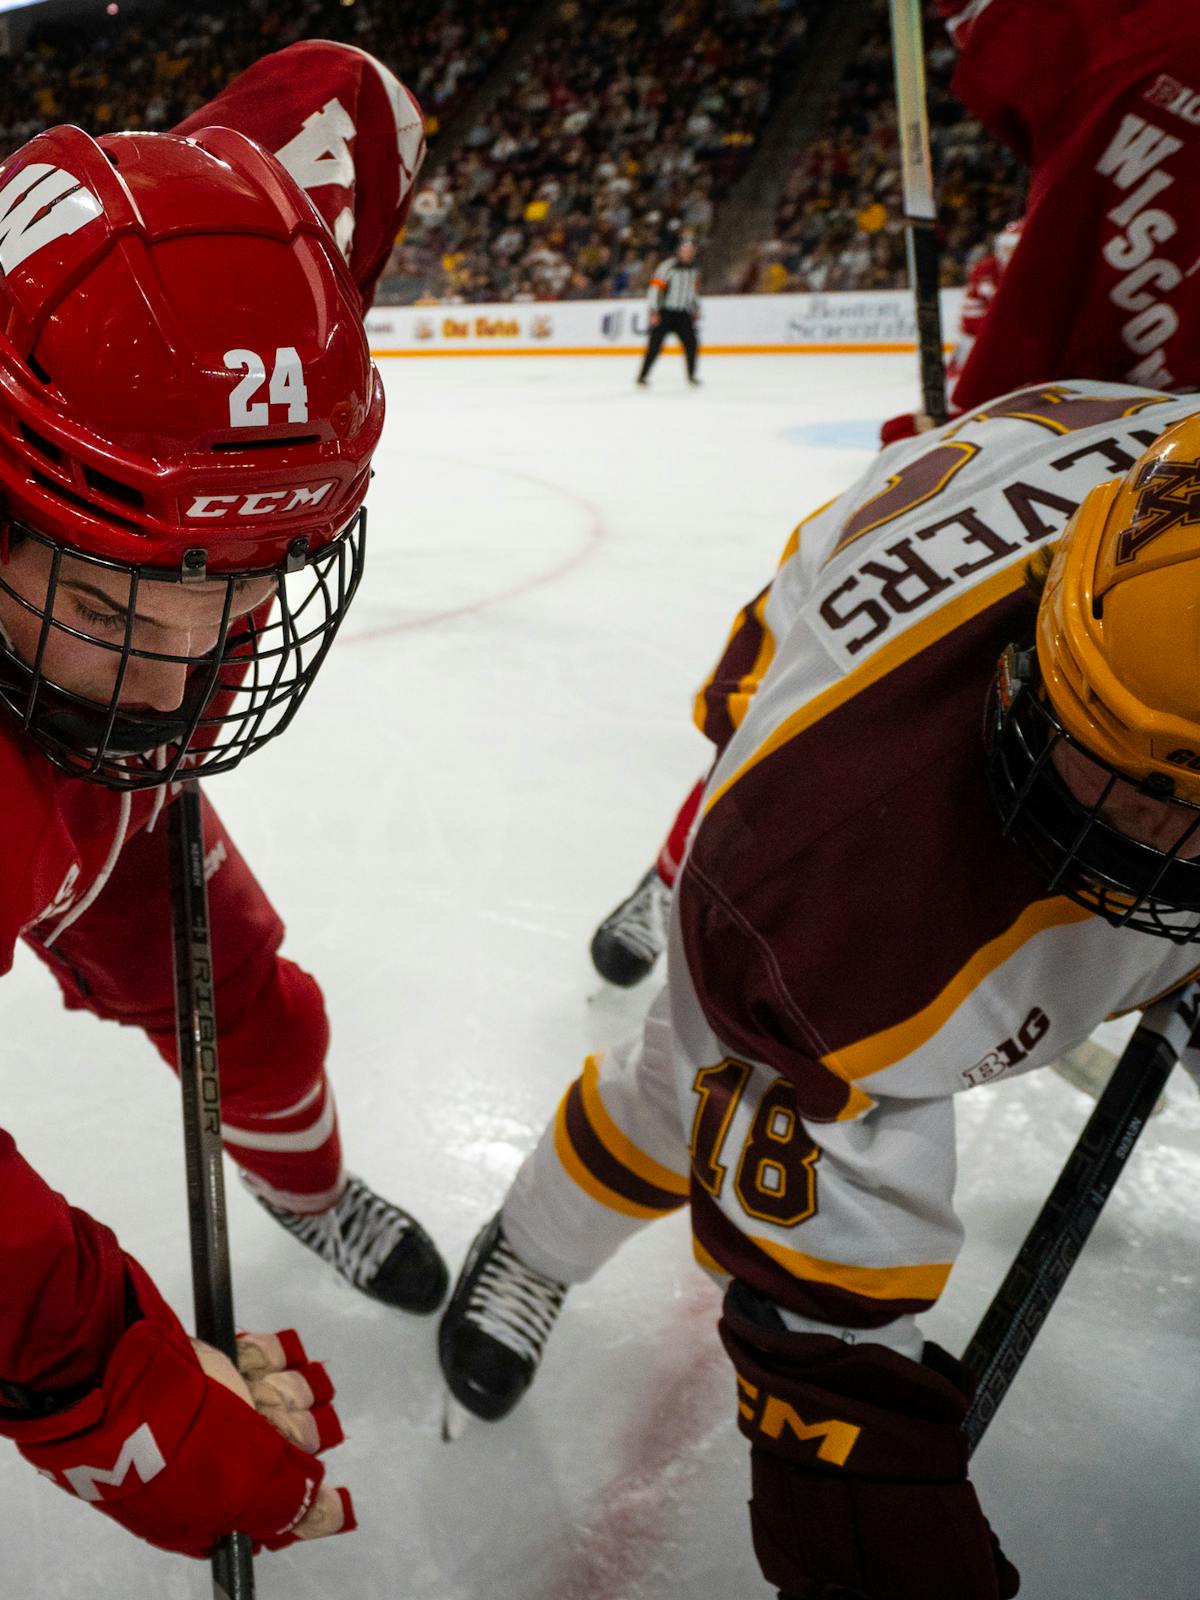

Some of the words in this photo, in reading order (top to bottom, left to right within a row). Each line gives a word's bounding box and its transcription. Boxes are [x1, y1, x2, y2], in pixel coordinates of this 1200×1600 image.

[223, 347, 309, 427] 24
[186, 482, 332, 518] CCM
[818, 420, 1175, 656] EVERS
[193, 955, 221, 1137] RIBCOR
[690, 1057, 821, 1227] 18
